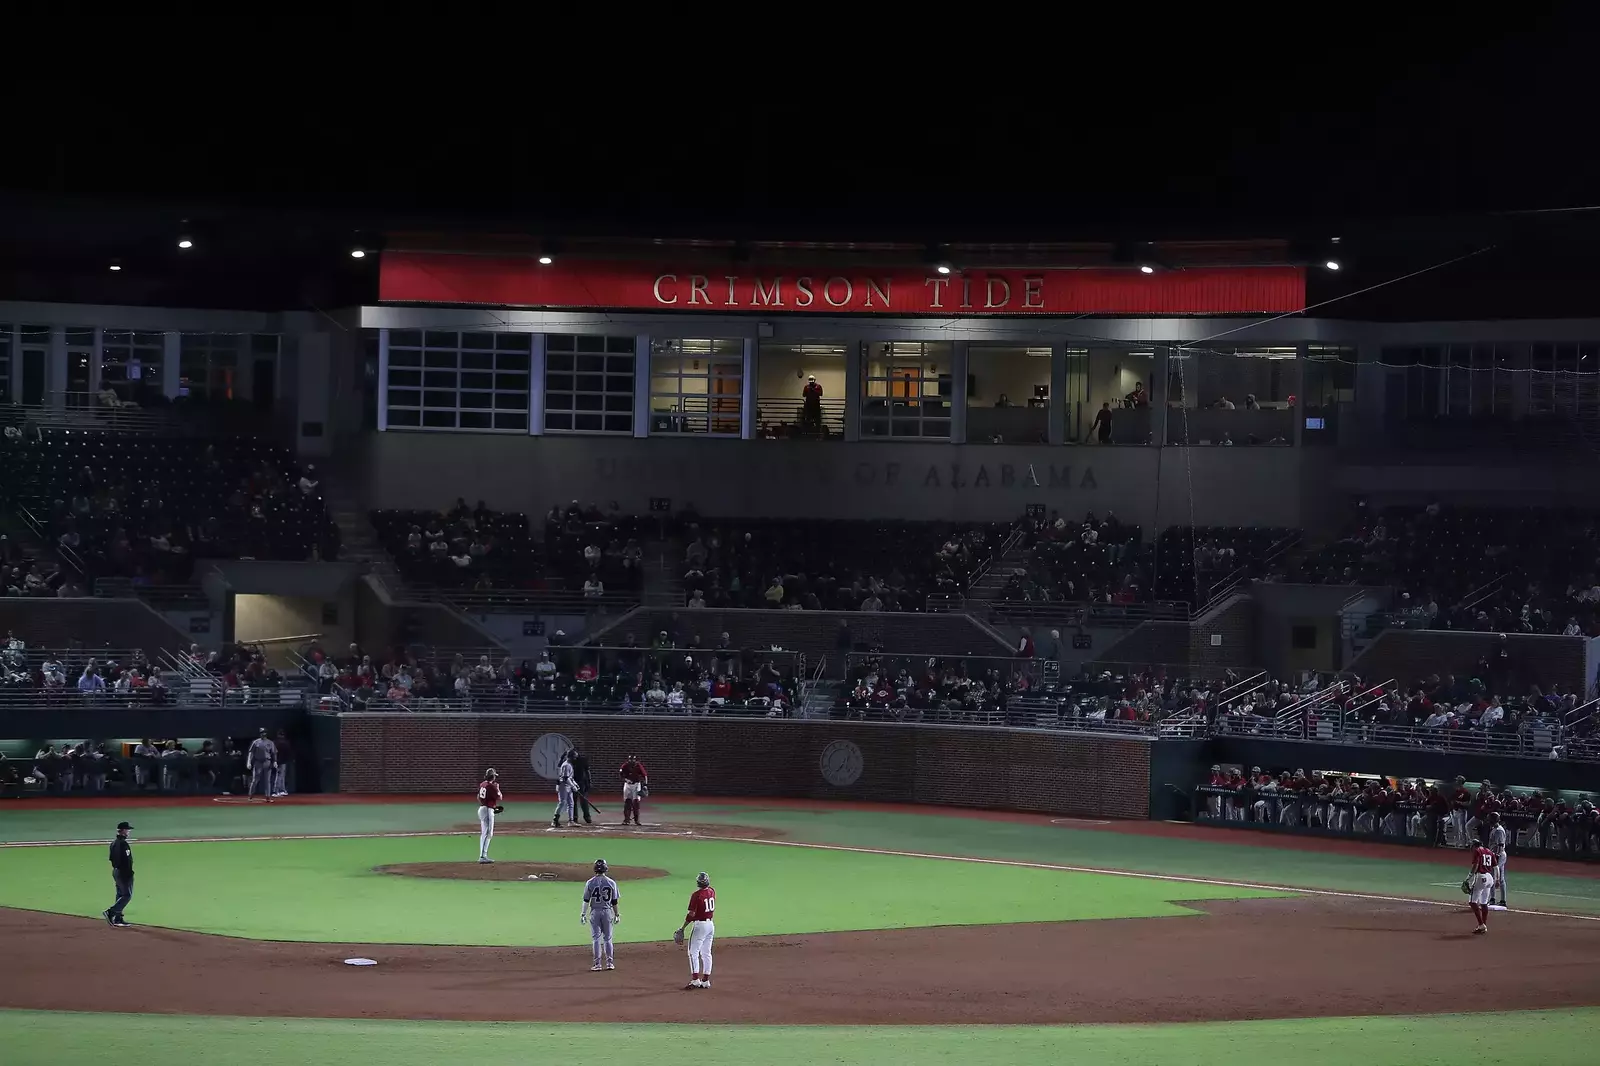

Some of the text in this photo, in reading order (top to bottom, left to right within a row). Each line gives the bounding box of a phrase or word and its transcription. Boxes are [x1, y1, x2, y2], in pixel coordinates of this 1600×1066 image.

[653, 274, 1045, 308] CRIMSON TIDE
[854, 461, 901, 487] OF
[924, 463, 1098, 489] ALABAMA
[1482, 853, 1492, 867] 13
[591, 885, 612, 904] 43
[703, 896, 715, 913] 10
